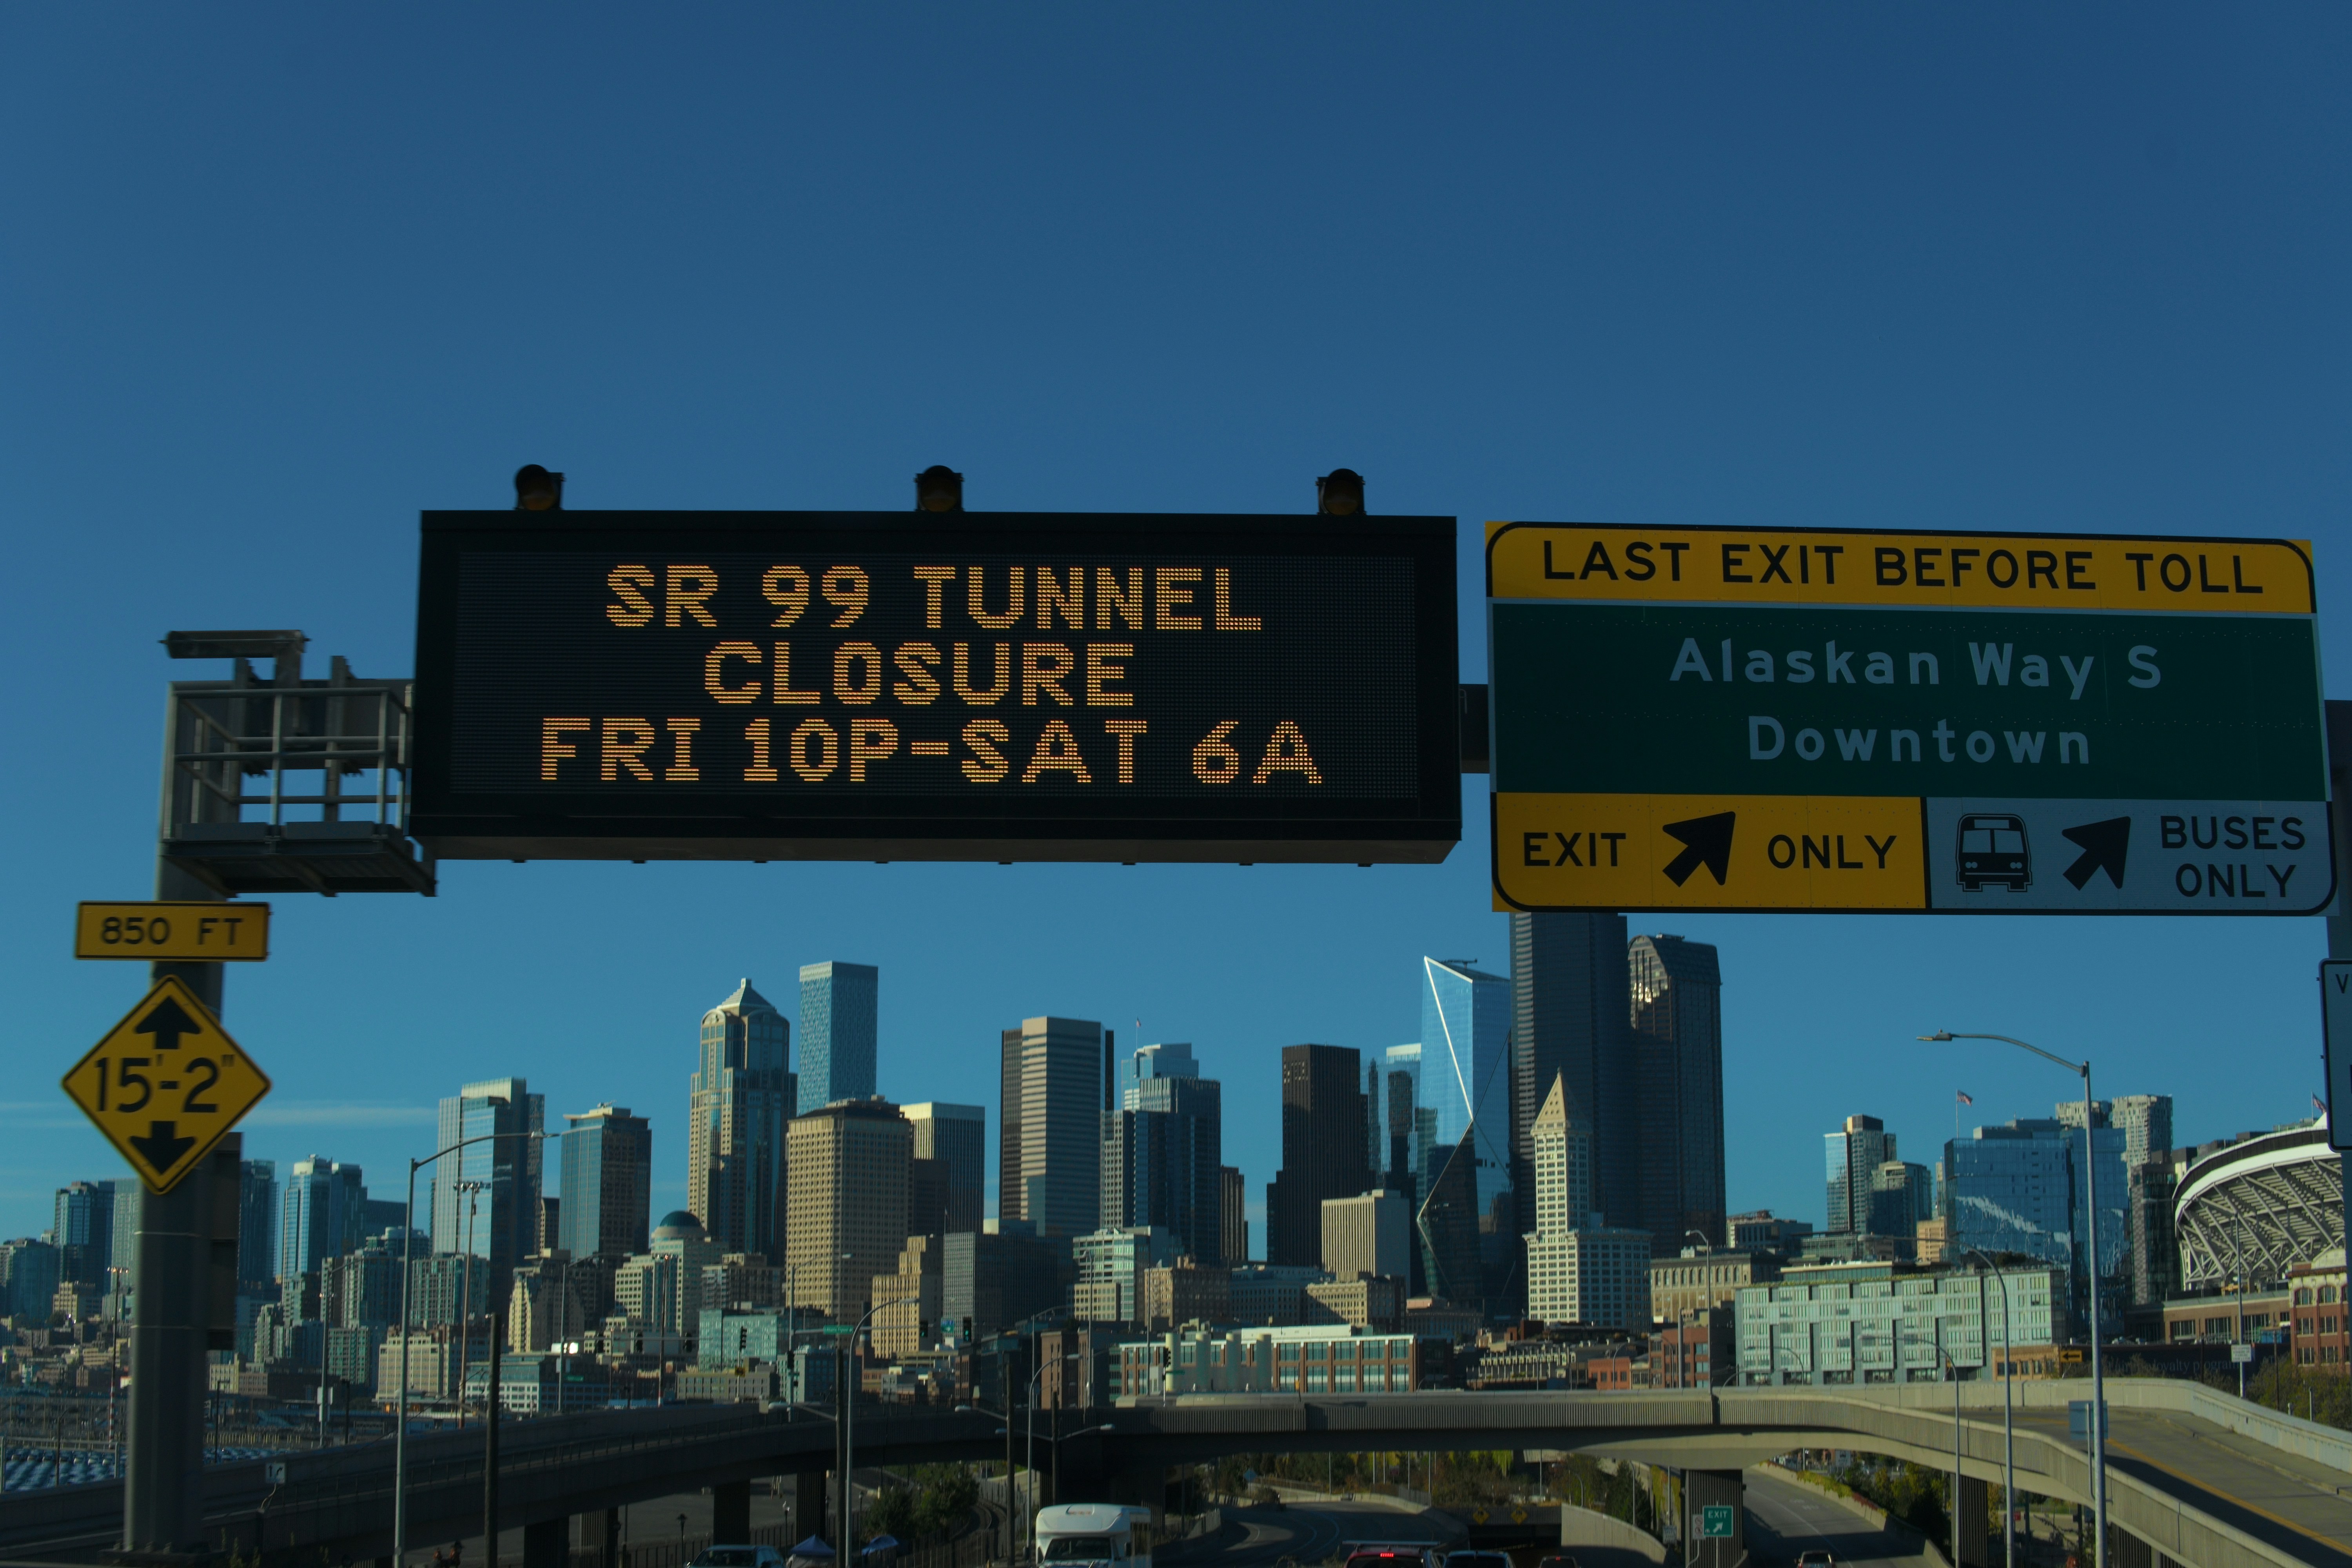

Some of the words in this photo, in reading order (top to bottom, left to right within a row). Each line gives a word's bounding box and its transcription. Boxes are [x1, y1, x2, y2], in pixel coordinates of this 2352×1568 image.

[1544, 541, 1689, 581] LAST
[1722, 544, 1844, 584] EXIT
[1876, 548, 2096, 590] BEFORE
[2126, 553, 2263, 594] TOLL
[607, 566, 718, 627] SR
[762, 566, 869, 628] 99
[914, 566, 1261, 630] TUNNEL
[705, 642, 1134, 706] CLOSURE
[1670, 637, 1940, 685] Alaskan
[1969, 642, 2095, 700] Way
[2126, 645, 2161, 689] S
[541, 718, 700, 781] FRI
[744, 719, 1147, 784] 10P-SAT
[1193, 722, 1322, 784] 6A
[1748, 715, 2090, 764] Downtown
[1524, 832, 1626, 867] EXIT
[1768, 835, 1896, 869] ONLY
[2161, 816, 2306, 851] BUSES
[2175, 862, 2296, 898] ONLY
[101, 916, 171, 945] 850
[198, 918, 245, 946] FT
[1708, 1510, 1728, 1519] EXIT
